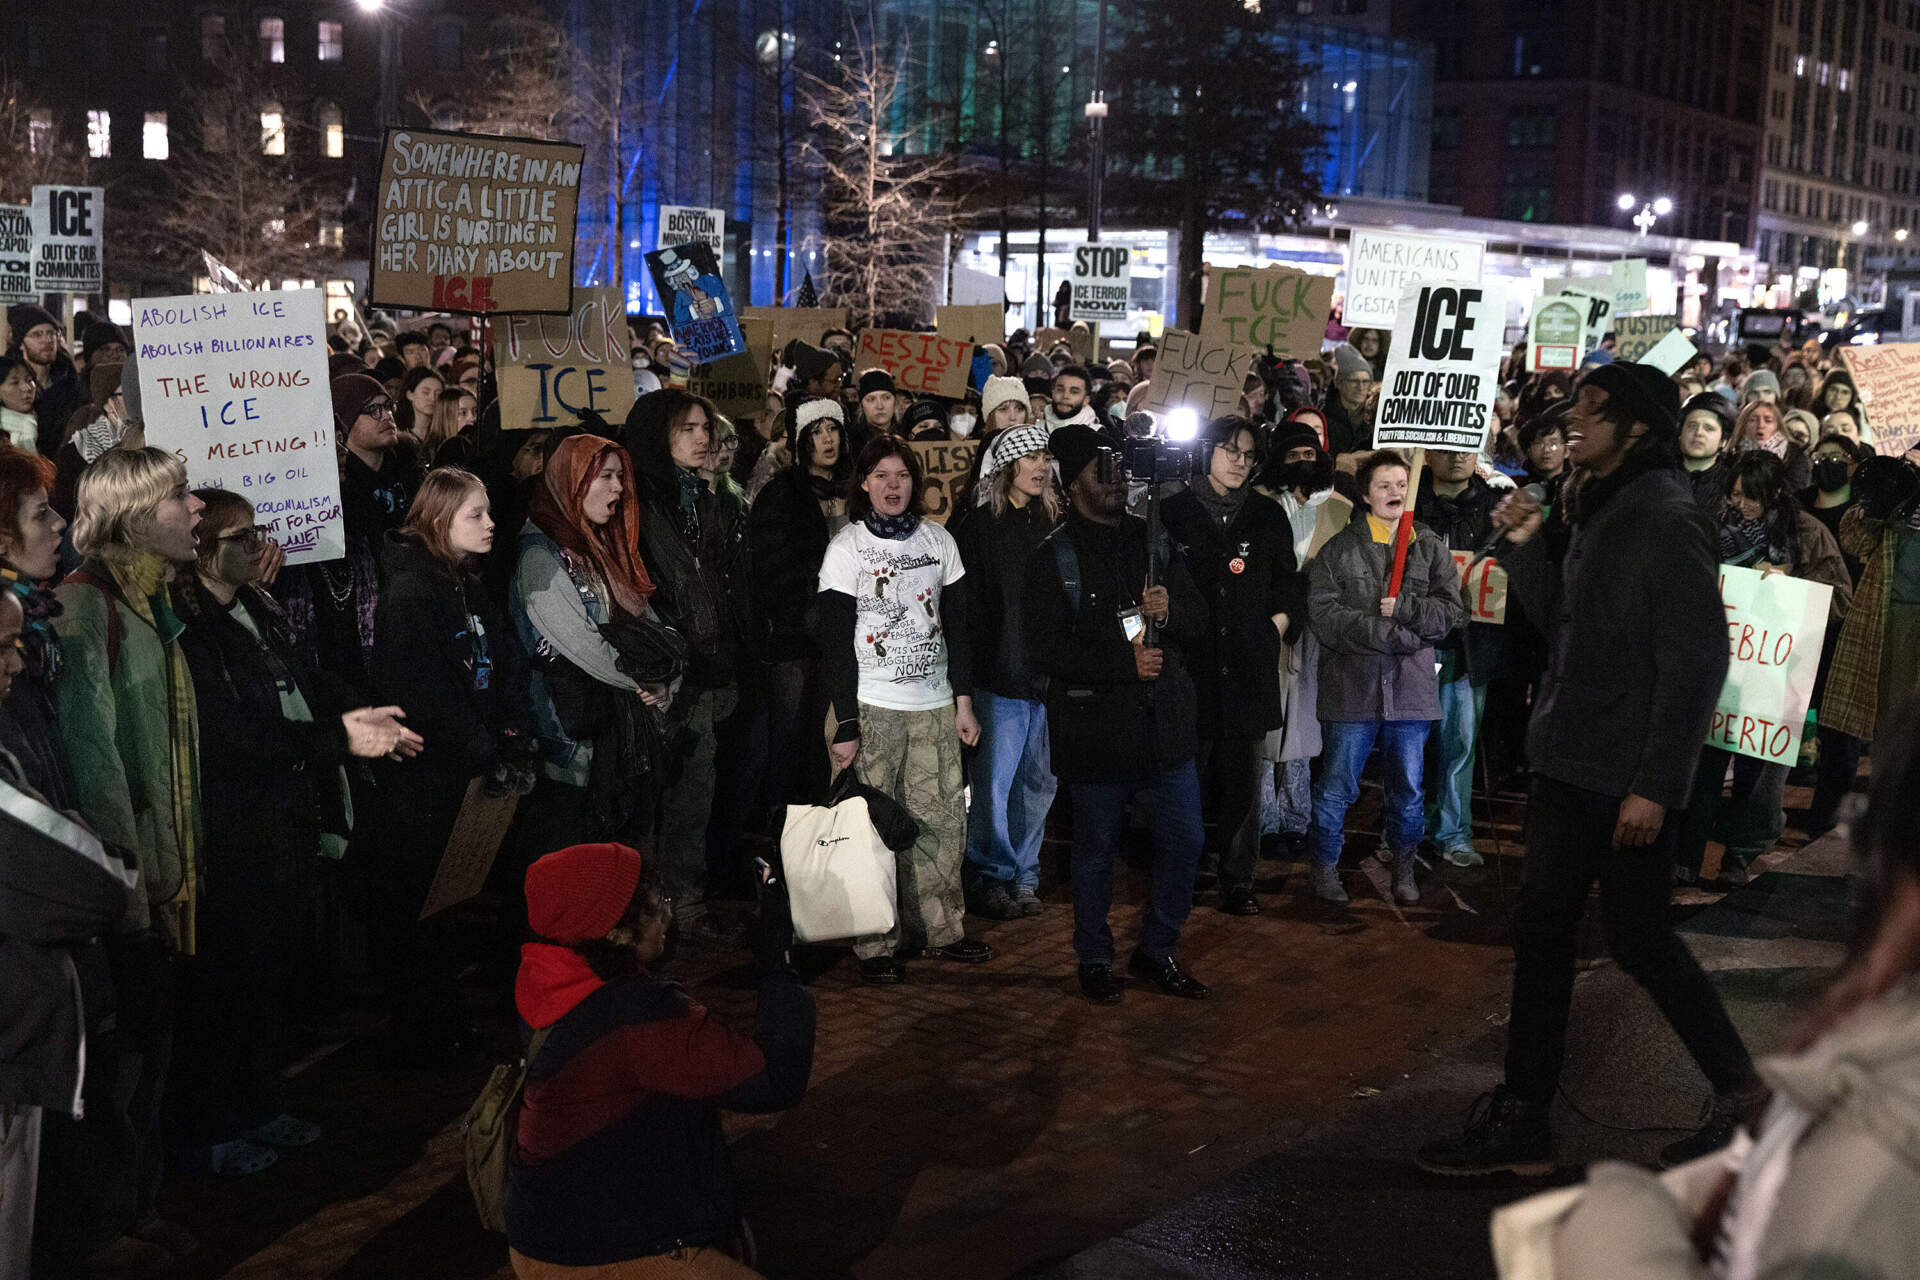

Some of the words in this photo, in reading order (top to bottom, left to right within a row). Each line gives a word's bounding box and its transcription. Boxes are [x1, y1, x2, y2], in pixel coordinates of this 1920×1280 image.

[392, 132, 521, 182] SOMEWHERE
[522, 158, 548, 184] IN
[547, 160, 581, 187] AN
[49, 190, 93, 237] ICE
[480, 184, 557, 222] LITTLE
[0, 216, 33, 237] STON
[380, 212, 429, 242] GIRL
[433, 213, 452, 241] IS
[456, 217, 536, 246] WRITING
[538, 224, 557, 244] IN
[668, 215, 716, 234] BOSTON
[42, 244, 63, 260] OUT
[65, 245, 79, 260] OF
[79, 246, 97, 261] OUR
[380, 242, 419, 272] HER
[426, 243, 480, 276] DIARY
[485, 248, 564, 279] ABOUT
[1075, 246, 1129, 278] STOP
[1358, 238, 1460, 271] AMERICANS
[1074, 284, 1090, 299] ICE
[1091, 285, 1128, 300] TERROR
[1074, 300, 1127, 311] NOW!
[1218, 271, 1315, 321] FUCK
[1352, 294, 1397, 315] GESTA
[140, 303, 227, 328] ABOLISH
[253, 301, 286, 318] ICE
[507, 295, 628, 364] FUCK
[1408, 287, 1483, 361] ICE
[140, 341, 203, 360] ABOLISH
[211, 335, 315, 353] BILLIONAIRES
[1222, 314, 1289, 352] ICE
[862, 333, 971, 368] RESIST
[1161, 332, 1248, 382] FUCK
[157, 373, 209, 398] THE
[229, 369, 310, 390] WRONG
[881, 360, 945, 392] ICE
[1392, 371, 1425, 398] OUT
[1423, 372, 1446, 399] OF
[1445, 373, 1480, 401] OUR
[525, 363, 611, 422] ICE
[201, 398, 260, 429] ICE
[1381, 398, 1487, 430] COMMUNITIES
[1405, 430, 1437, 442] SOCIALISM
[1444, 432, 1481, 445] LIBERATION
[175, 448, 188, 464] S
[243, 472, 276, 488] BIG
[285, 467, 309, 480] OIL
[256, 495, 332, 514] COLONIALISM
[286, 513, 318, 531] FOR
[318, 505, 343, 520] OUR
[886, 645, 908, 655] THIS
[910, 642, 941, 655] LITTLE
[1728, 622, 1794, 666] EBLO
[877, 656, 913, 667] PIGGIE
[915, 654, 938, 666] FACE
[1711, 711, 1791, 757] PERTO
